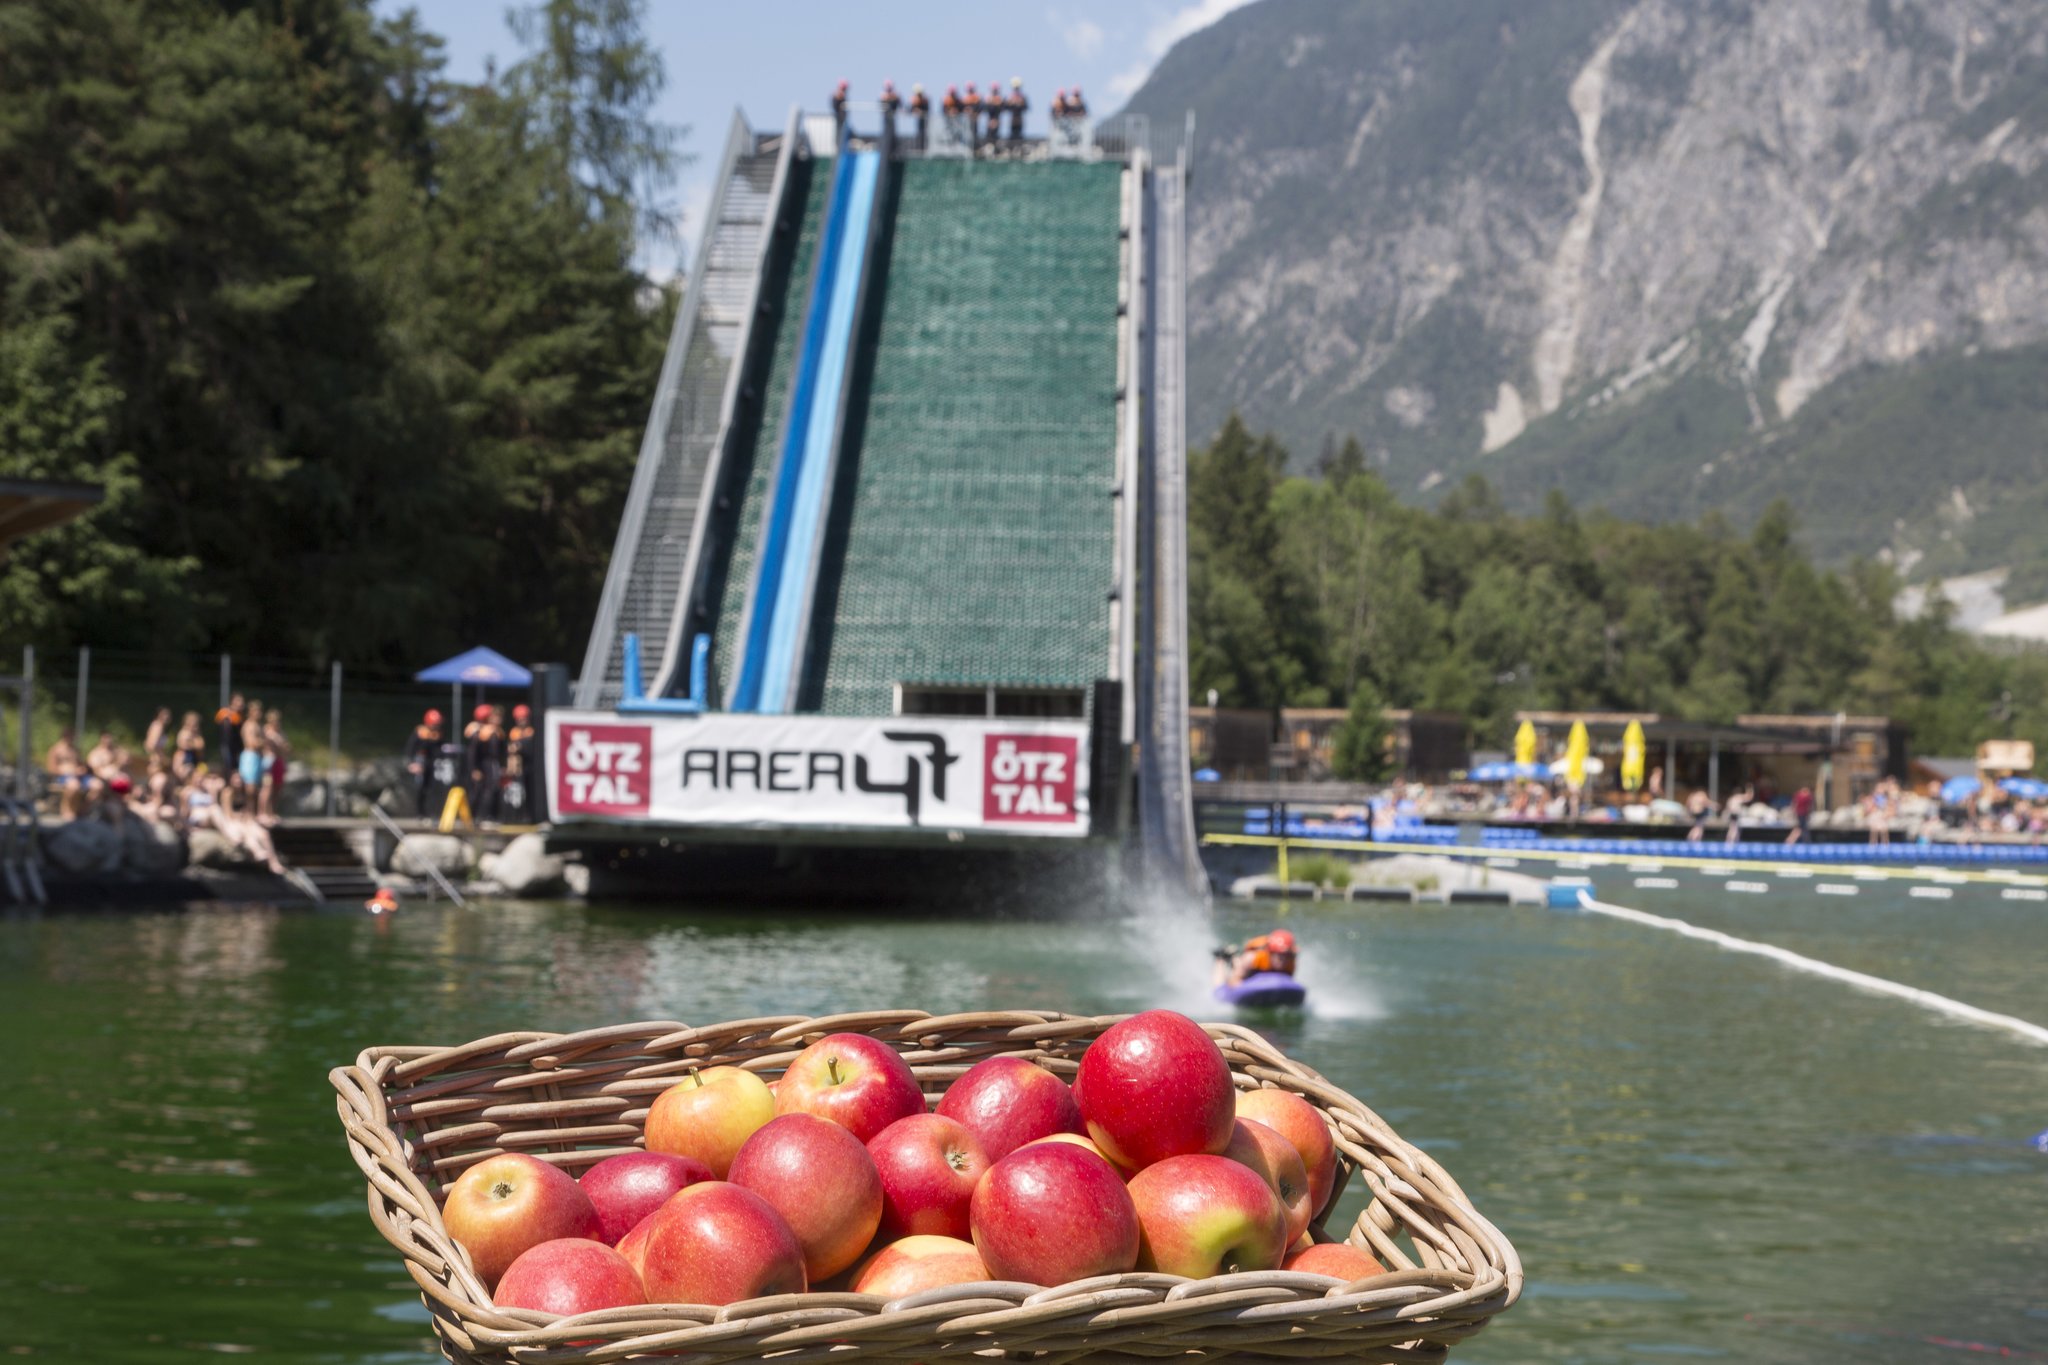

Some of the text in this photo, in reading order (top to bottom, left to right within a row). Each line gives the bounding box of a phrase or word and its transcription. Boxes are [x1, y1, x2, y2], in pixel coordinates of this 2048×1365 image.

[566, 730, 642, 772] ÖTZ
[991, 740, 1067, 783] ÖTZ
[564, 772, 641, 805] TAL
[991, 783, 1068, 815] TAL
